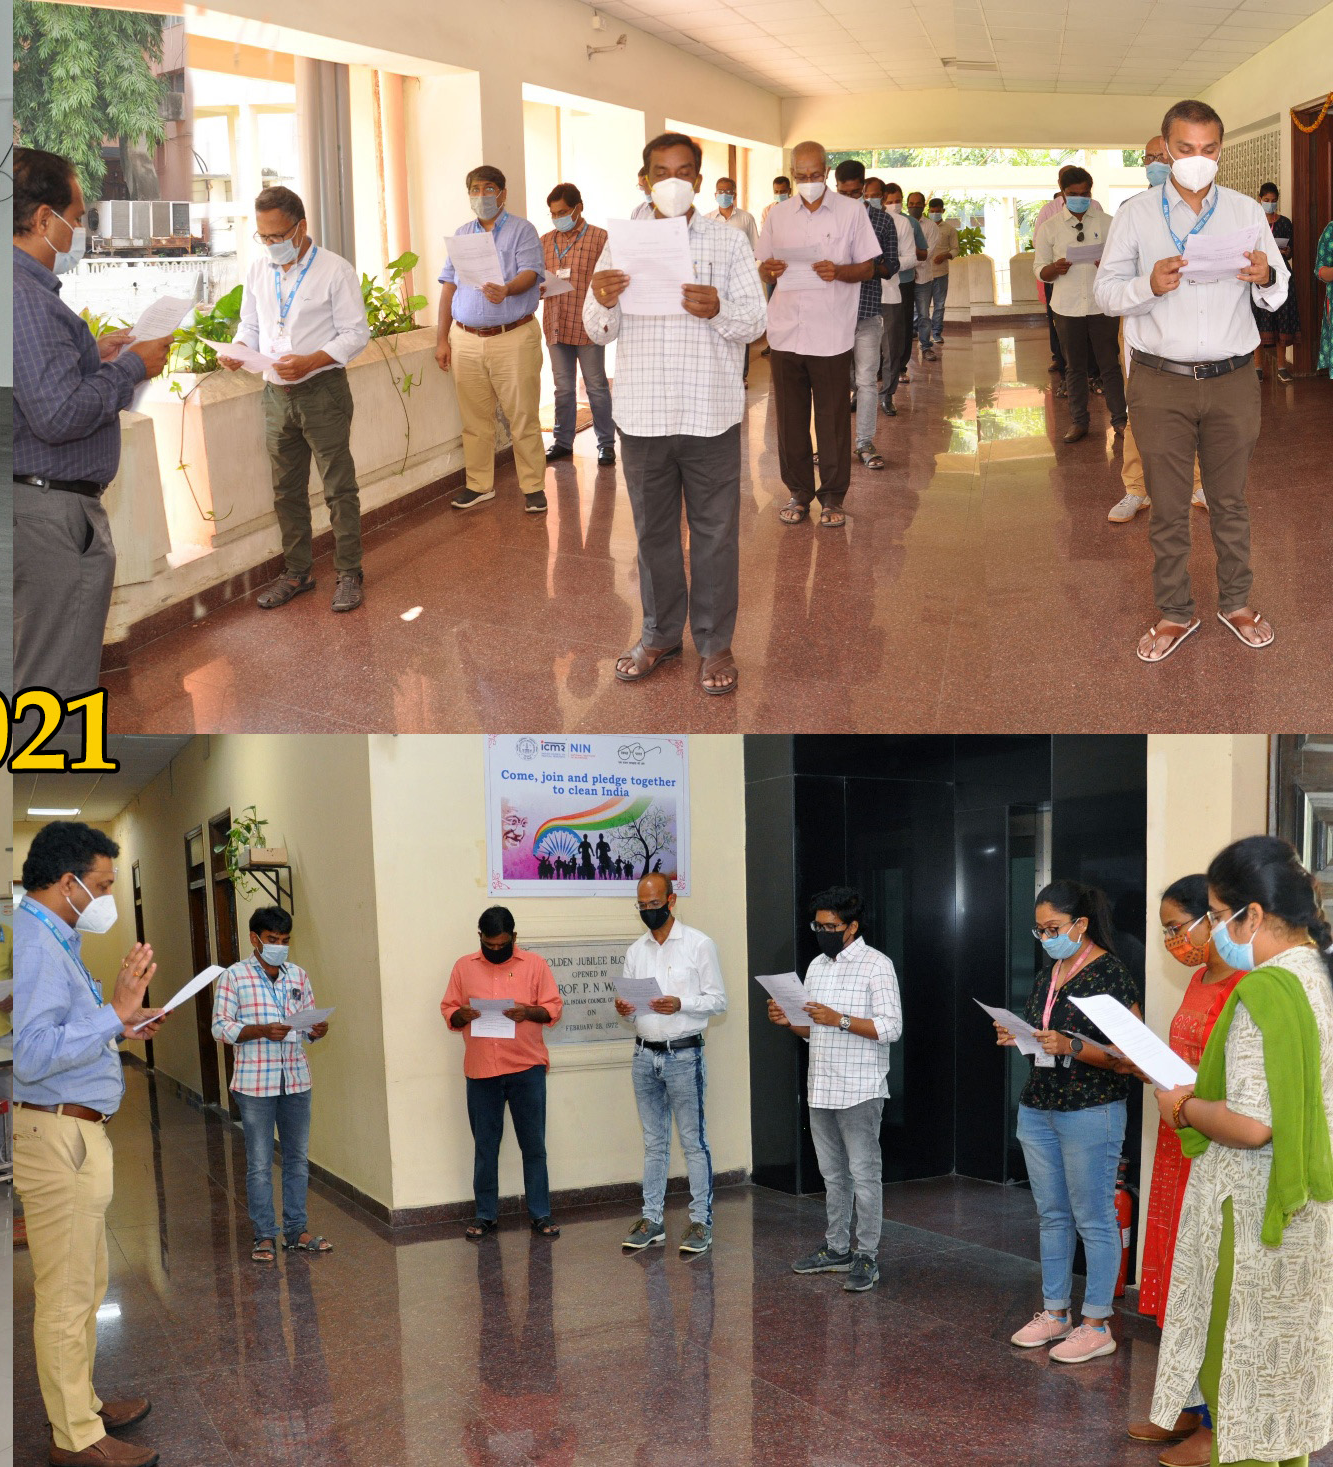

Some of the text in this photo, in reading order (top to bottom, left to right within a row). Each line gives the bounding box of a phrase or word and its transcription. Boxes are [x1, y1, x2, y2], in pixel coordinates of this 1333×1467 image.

[570, 743, 592, 754] NIN
[501, 769, 677, 788] Come, join and pledge together
[553, 784, 630, 797] to clean India
[547, 955, 626, 967] OLDEN JUBILEE BLO
[572, 970, 598, 978] OPENED
[557, 983, 580, 996] ROF.
[583, 982, 591, 993] P.
[565, 1023, 593, 1031] FEBRUARY
